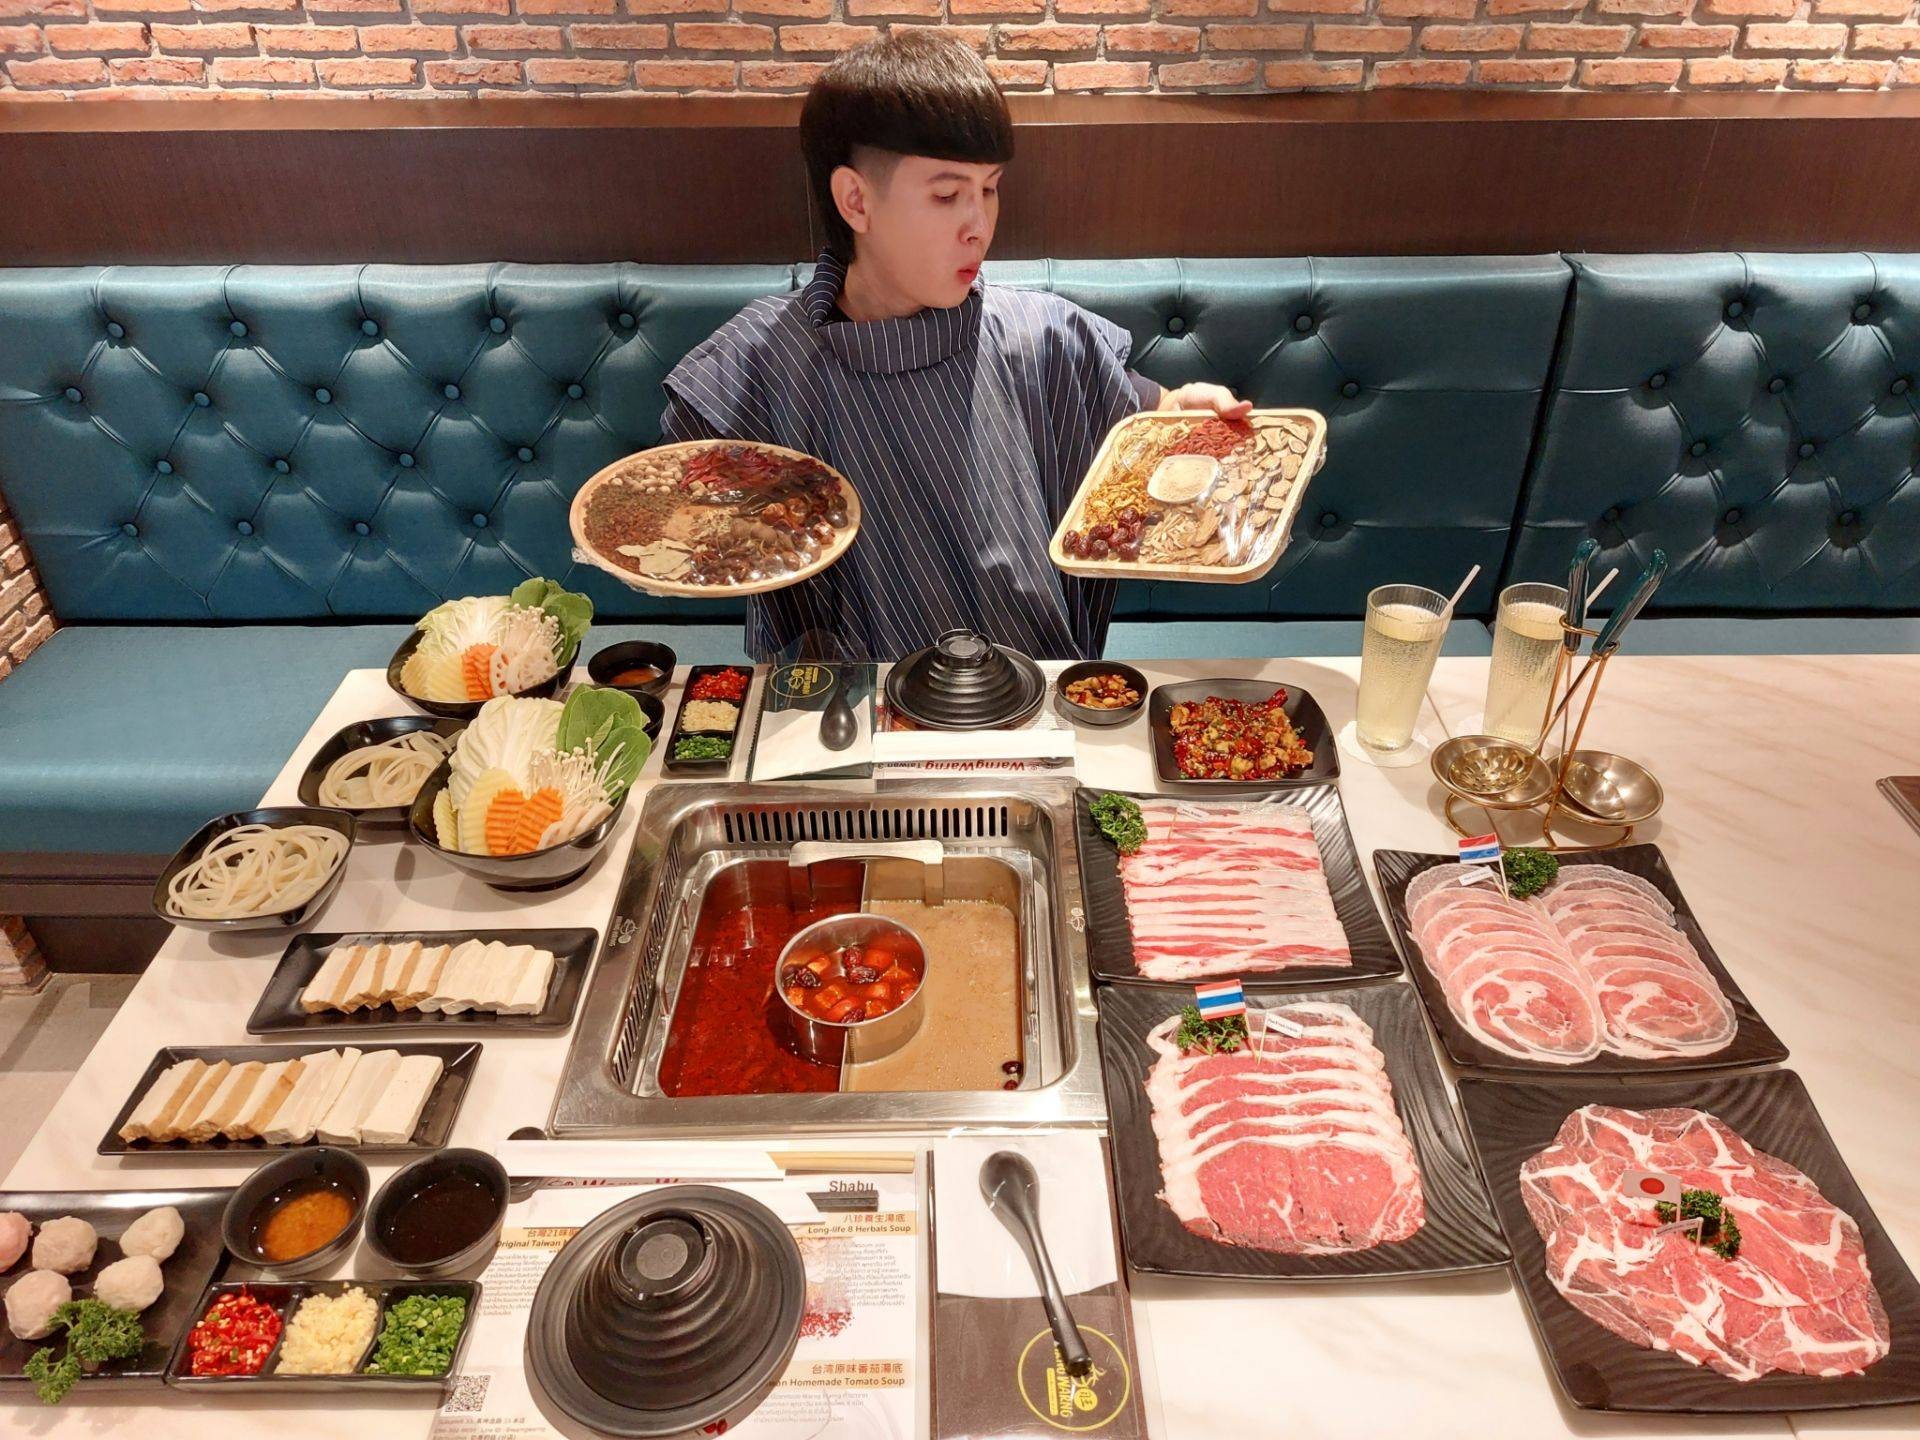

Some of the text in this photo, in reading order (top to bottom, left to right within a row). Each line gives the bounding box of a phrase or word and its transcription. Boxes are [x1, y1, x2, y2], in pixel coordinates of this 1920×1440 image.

[925, 759, 1024, 772] WarngWarng
[829, 1180, 874, 1193] Shabu
[808, 1224, 911, 1235] Long-life 8 Herbals Soup
[532, 1239, 561, 1247] Taiwan
[790, 1378, 842, 1387] Homemade
[844, 1377, 879, 1386] Tomato
[881, 1376, 905, 1386] Soup
